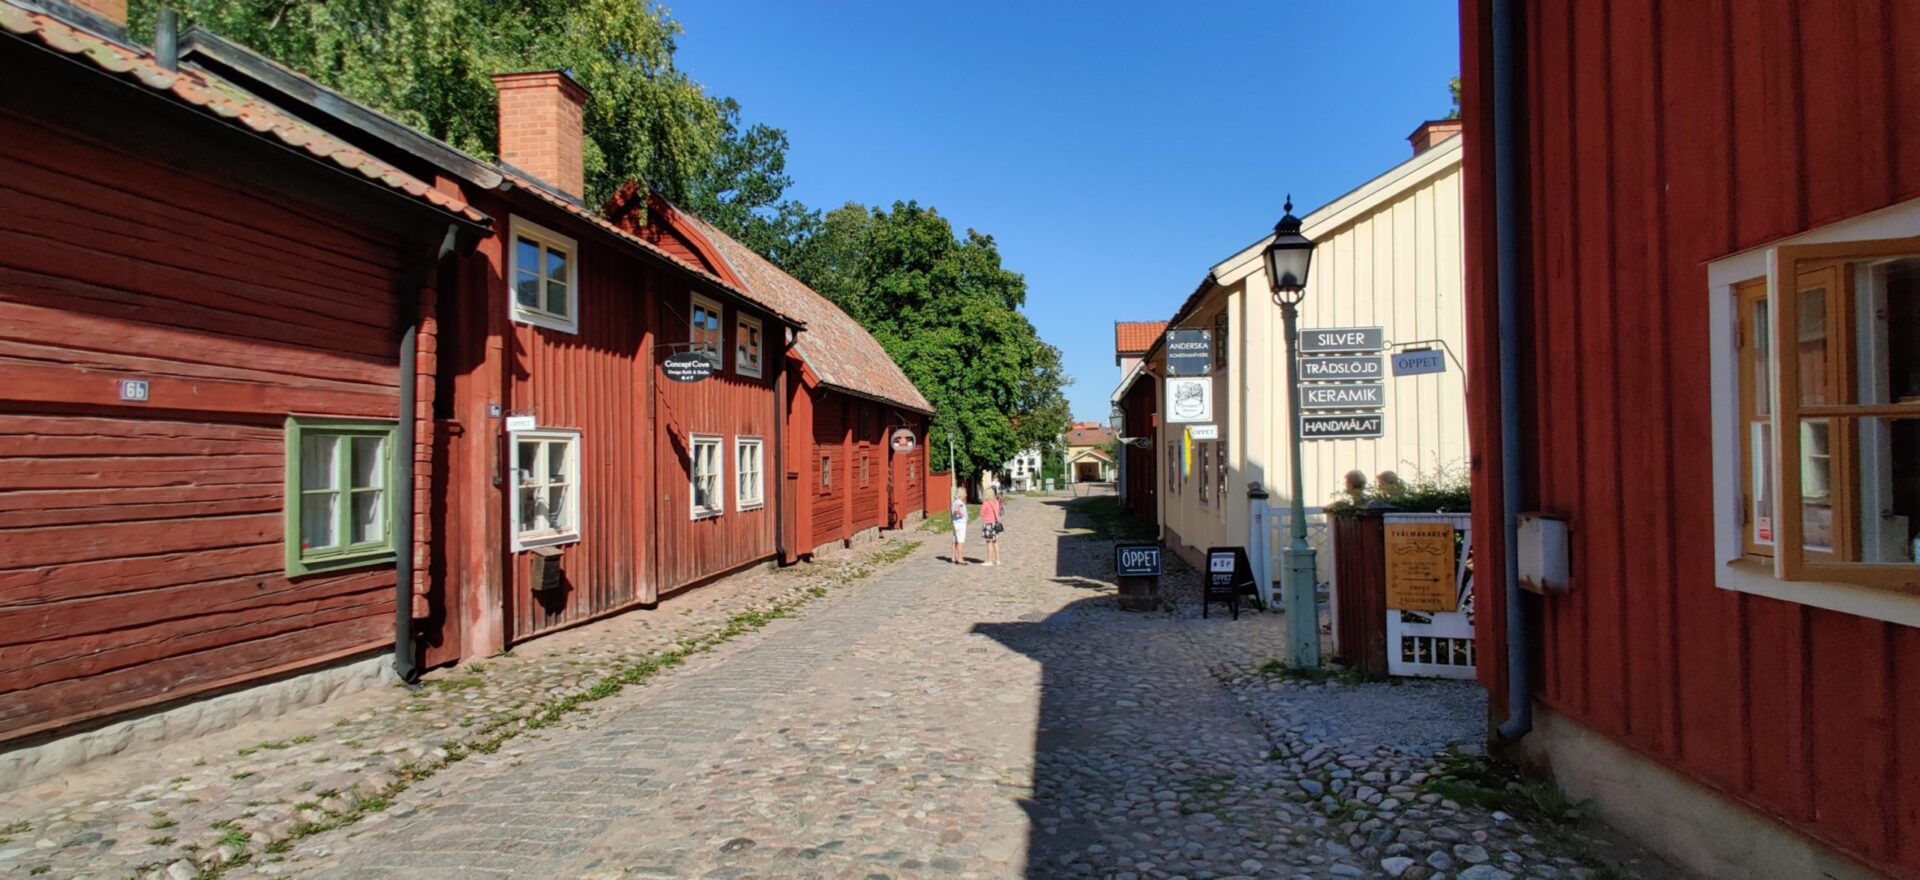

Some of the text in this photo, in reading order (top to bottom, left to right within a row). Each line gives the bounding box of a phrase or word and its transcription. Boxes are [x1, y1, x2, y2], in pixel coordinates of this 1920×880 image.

[1169, 342, 1209, 350] ANDERSKA
[1317, 332, 1365, 346] SILVER
[664, 359, 710, 369] Concept Cove
[1305, 360, 1378, 375] TRÅDSLÖJD
[126, 382, 145, 398] 6b
[1308, 388, 1377, 402] KERAMIK
[1304, 418, 1379, 433] HANDMÅLAT
[1122, 549, 1158, 567] ÖPPET
